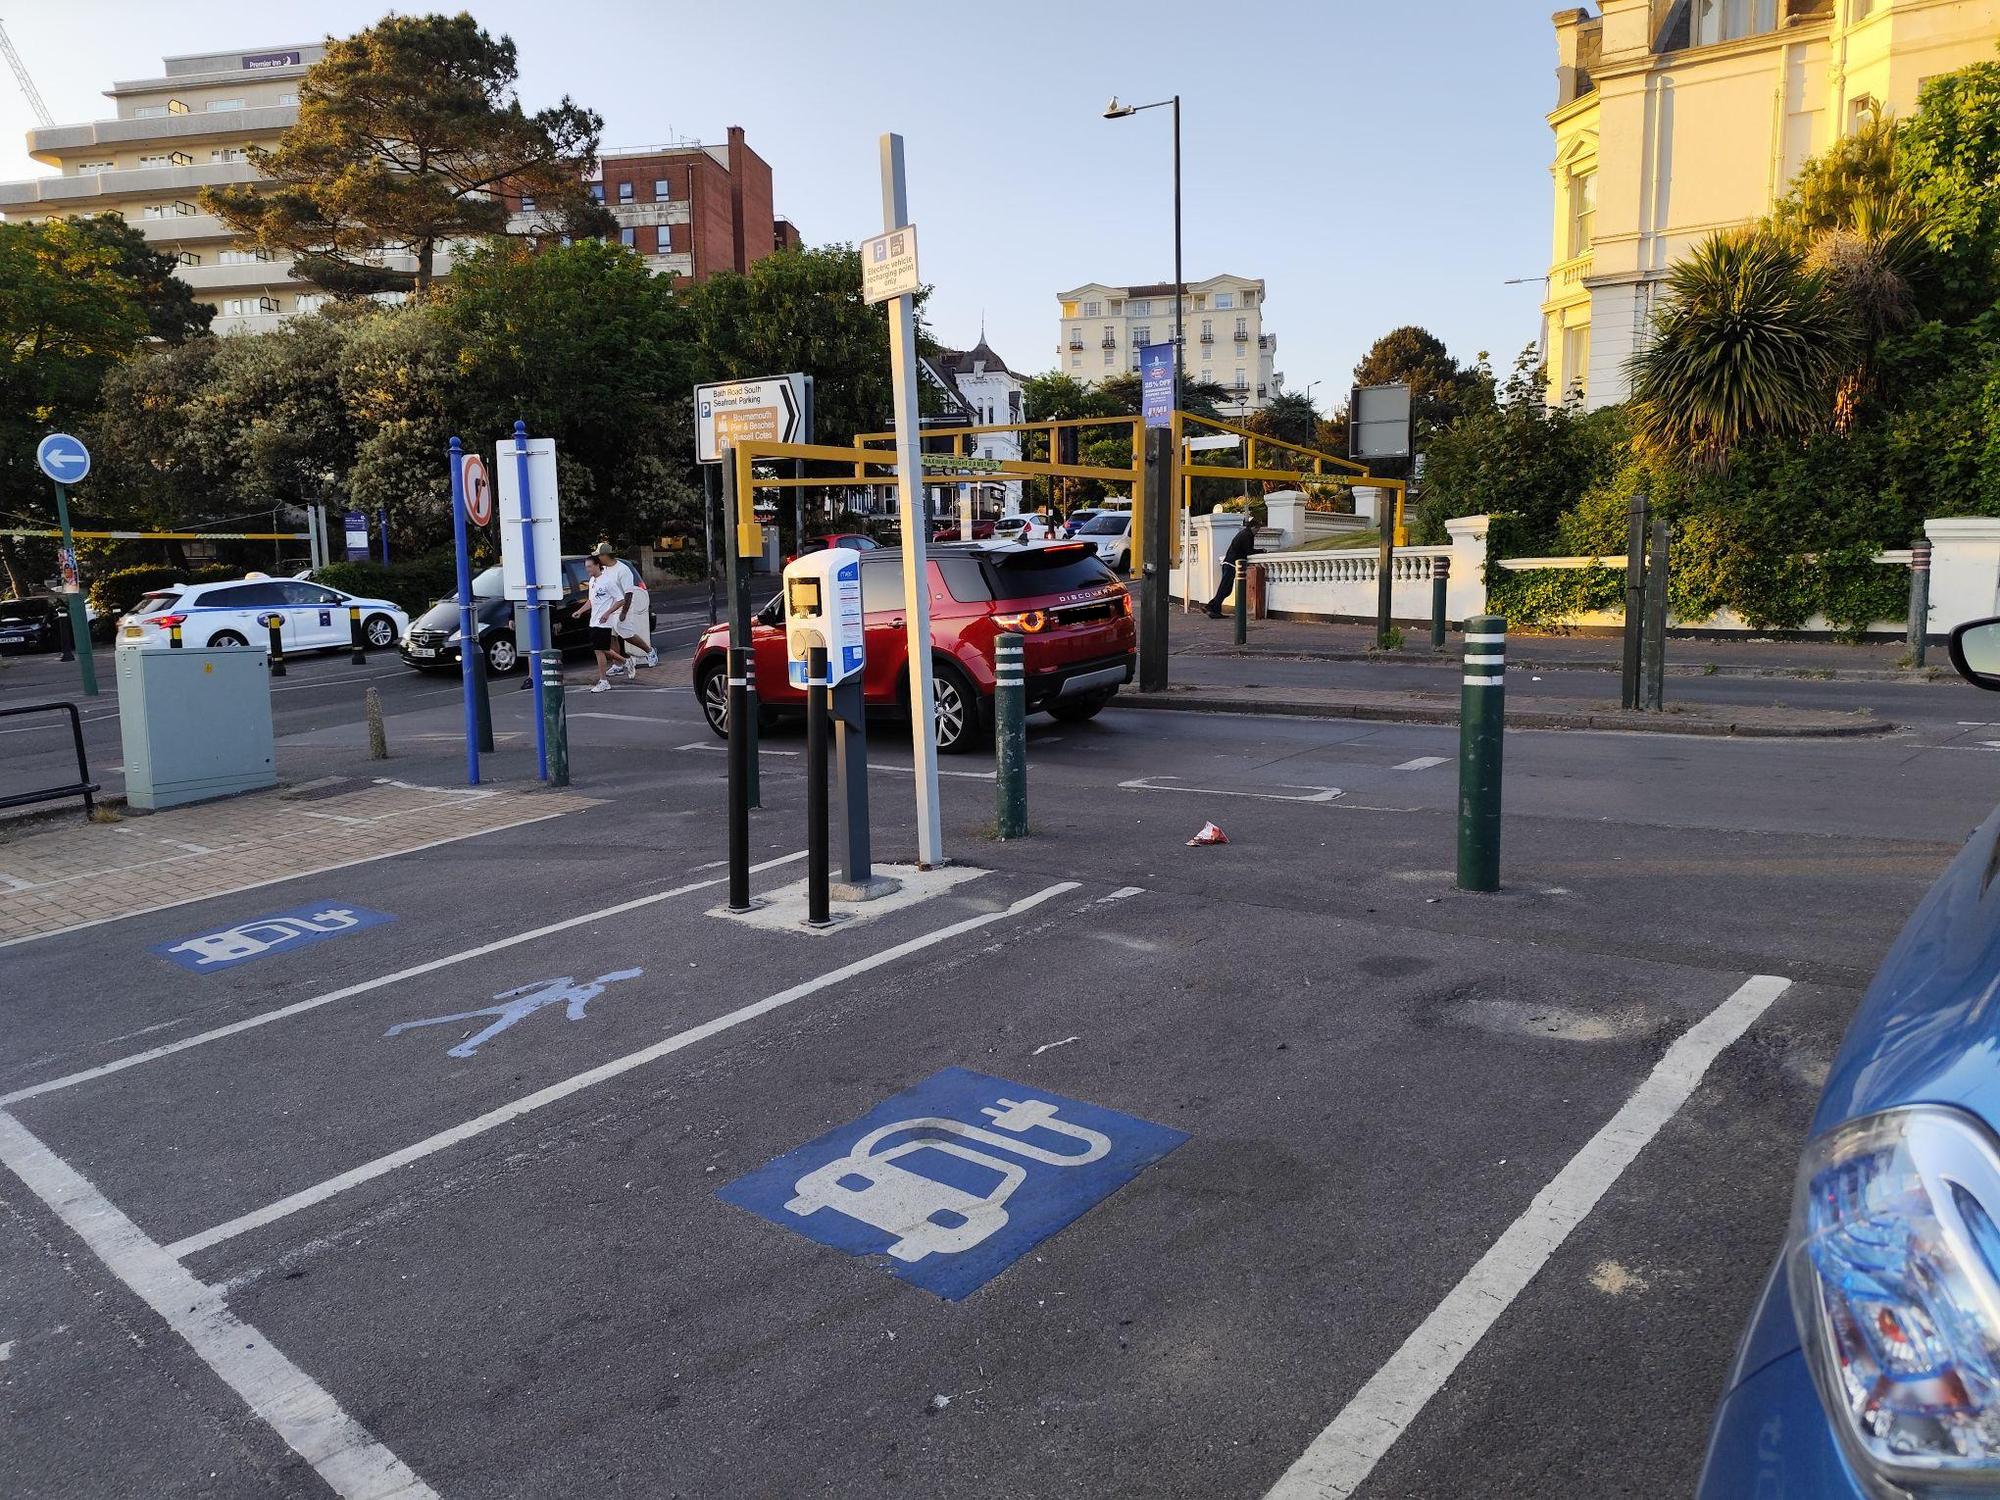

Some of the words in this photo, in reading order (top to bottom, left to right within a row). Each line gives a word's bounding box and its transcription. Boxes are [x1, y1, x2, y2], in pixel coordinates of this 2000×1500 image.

[249, 60, 271, 68] Premier
[271, 59, 282, 67] Inn
[867, 263, 890, 276] Electric
[891, 256, 912, 268] vehicle
[866, 269, 898, 284] recharging
[898, 263, 914, 276] point
[884, 277, 897, 286] only
[1159, 378, 1172, 387] OFF
[713, 388, 726, 398] Bath
[727, 386, 742, 396] Road
[744, 385, 761, 394] South
[713, 398, 737, 407] Seafront
[738, 396, 761, 405] Parking
[733, 410, 772, 422] Bournemouth
[731, 423, 742, 431] Pier
[749, 421, 776, 431] Beaches
[733, 431, 754, 441] Russell
[755, 431, 773, 440] Cotes
[949, 459, 968, 467] HEIGHT
[977, 460, 997, 468] METRES
[1059, 588, 1113, 602] DISCOVERY
